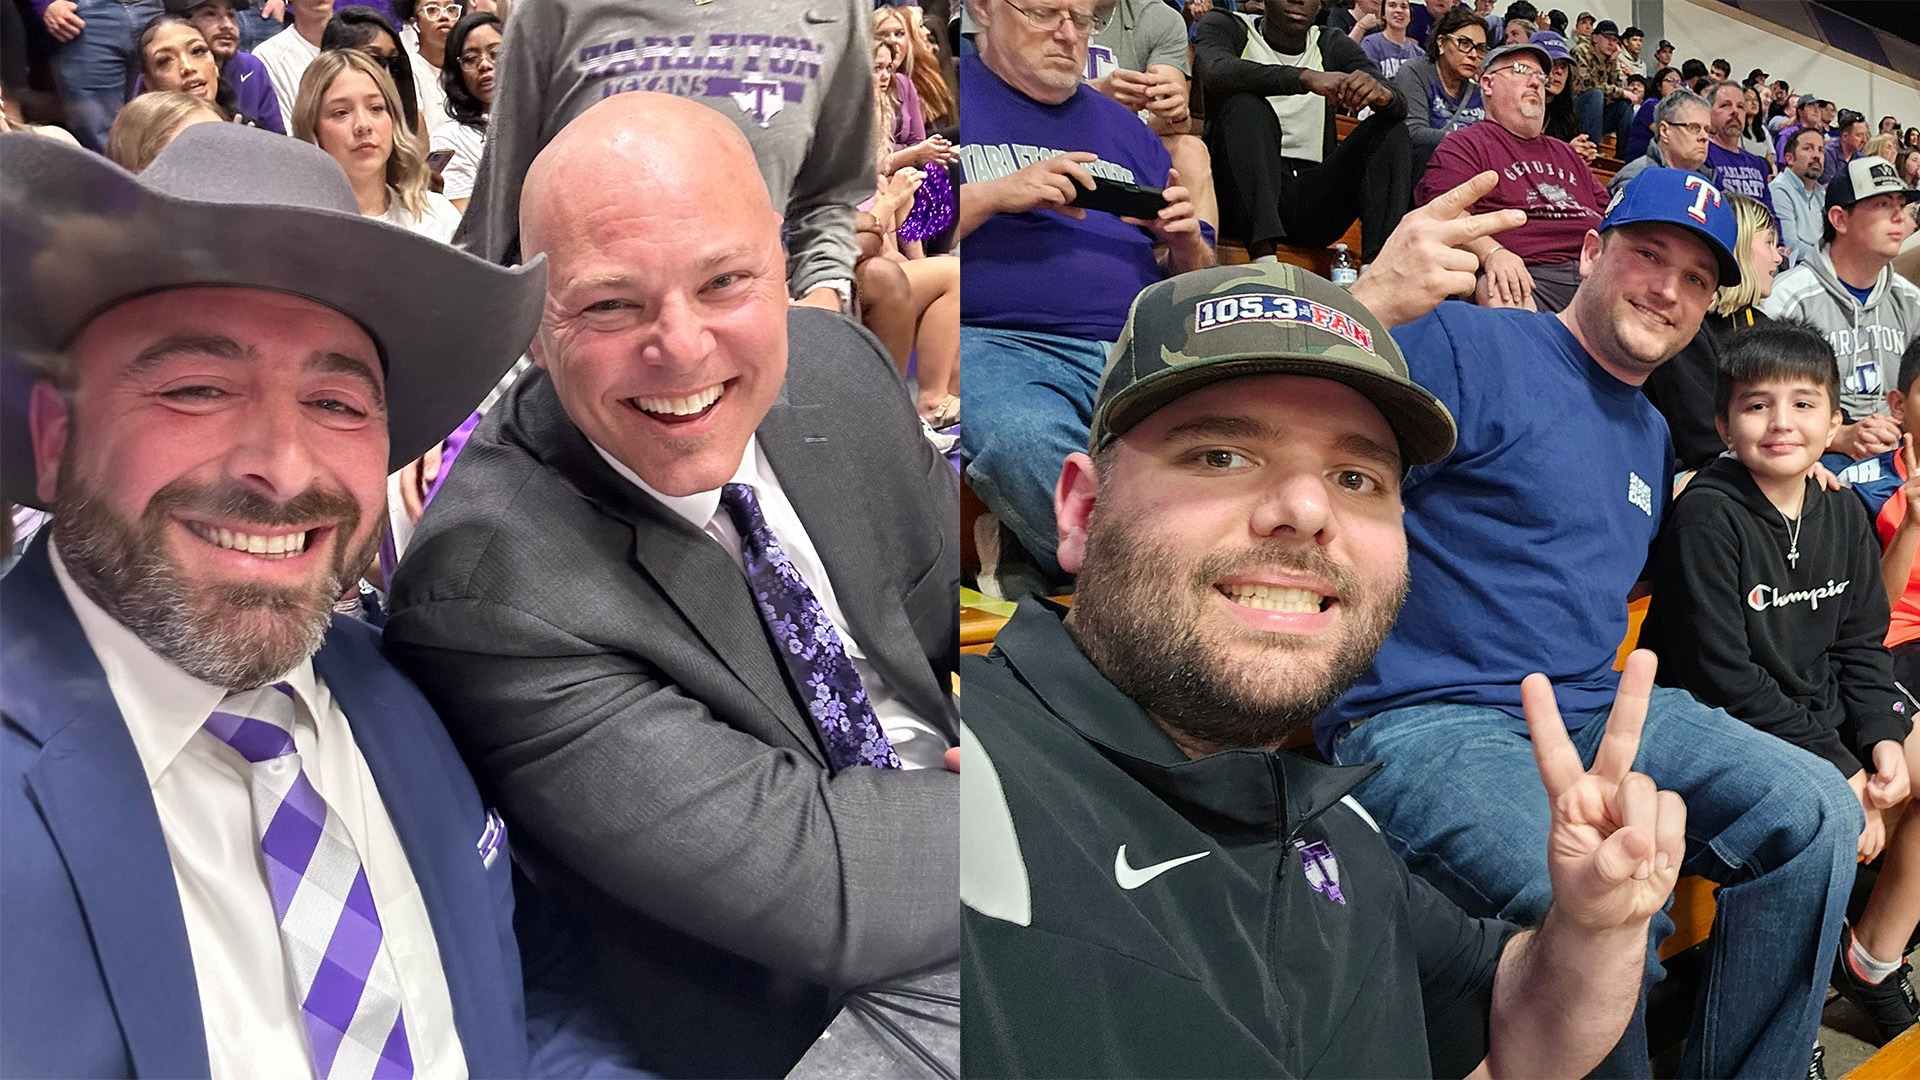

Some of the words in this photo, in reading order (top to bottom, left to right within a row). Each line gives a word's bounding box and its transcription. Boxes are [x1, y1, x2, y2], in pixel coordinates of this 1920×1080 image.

[1685, 175, 1721, 224] T
[1200, 297, 1298, 328] 105.3
[1747, 579, 1850, 612] Champio
